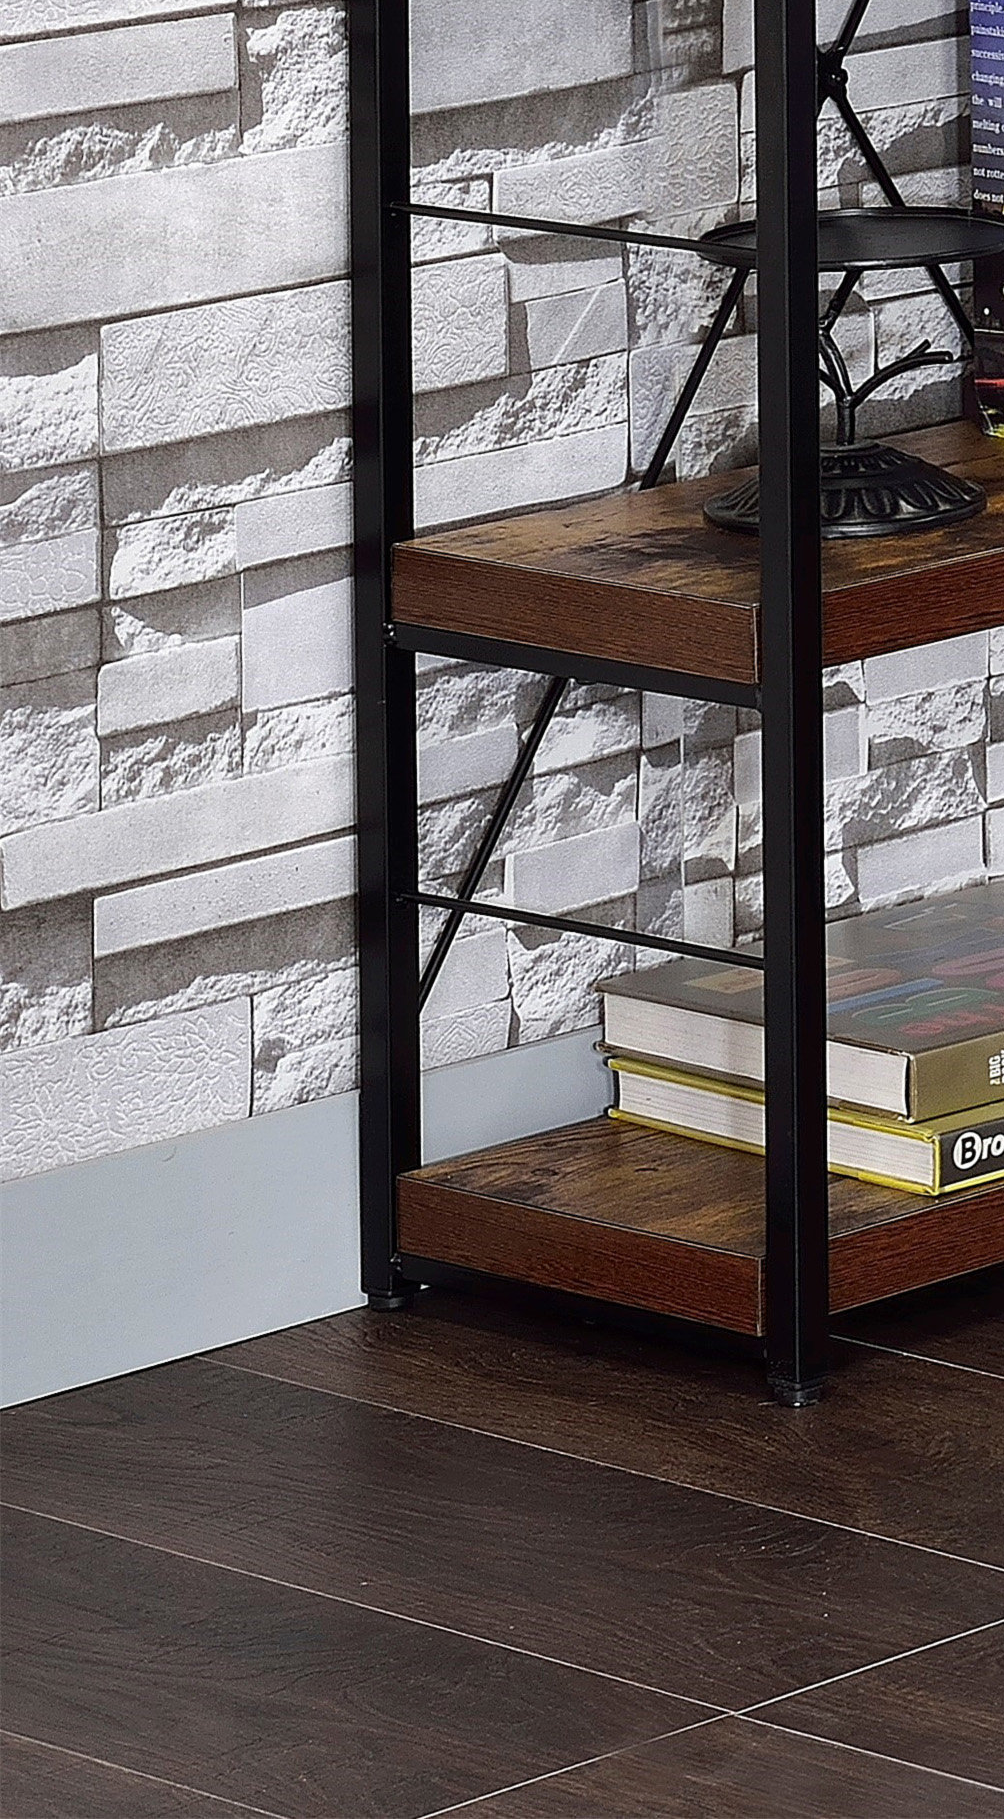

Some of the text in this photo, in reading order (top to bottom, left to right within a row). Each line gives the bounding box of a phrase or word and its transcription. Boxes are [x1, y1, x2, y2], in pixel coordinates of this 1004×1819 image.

[971, 94, 985, 106] the
[987, 96, 1003, 109] will
[972, 119, 1000, 134] melting
[972, 167, 985, 177] not
[973, 189, 991, 201] does
[991, 193, 1004, 203] not
[988, 1054, 1002, 1079] BIG
